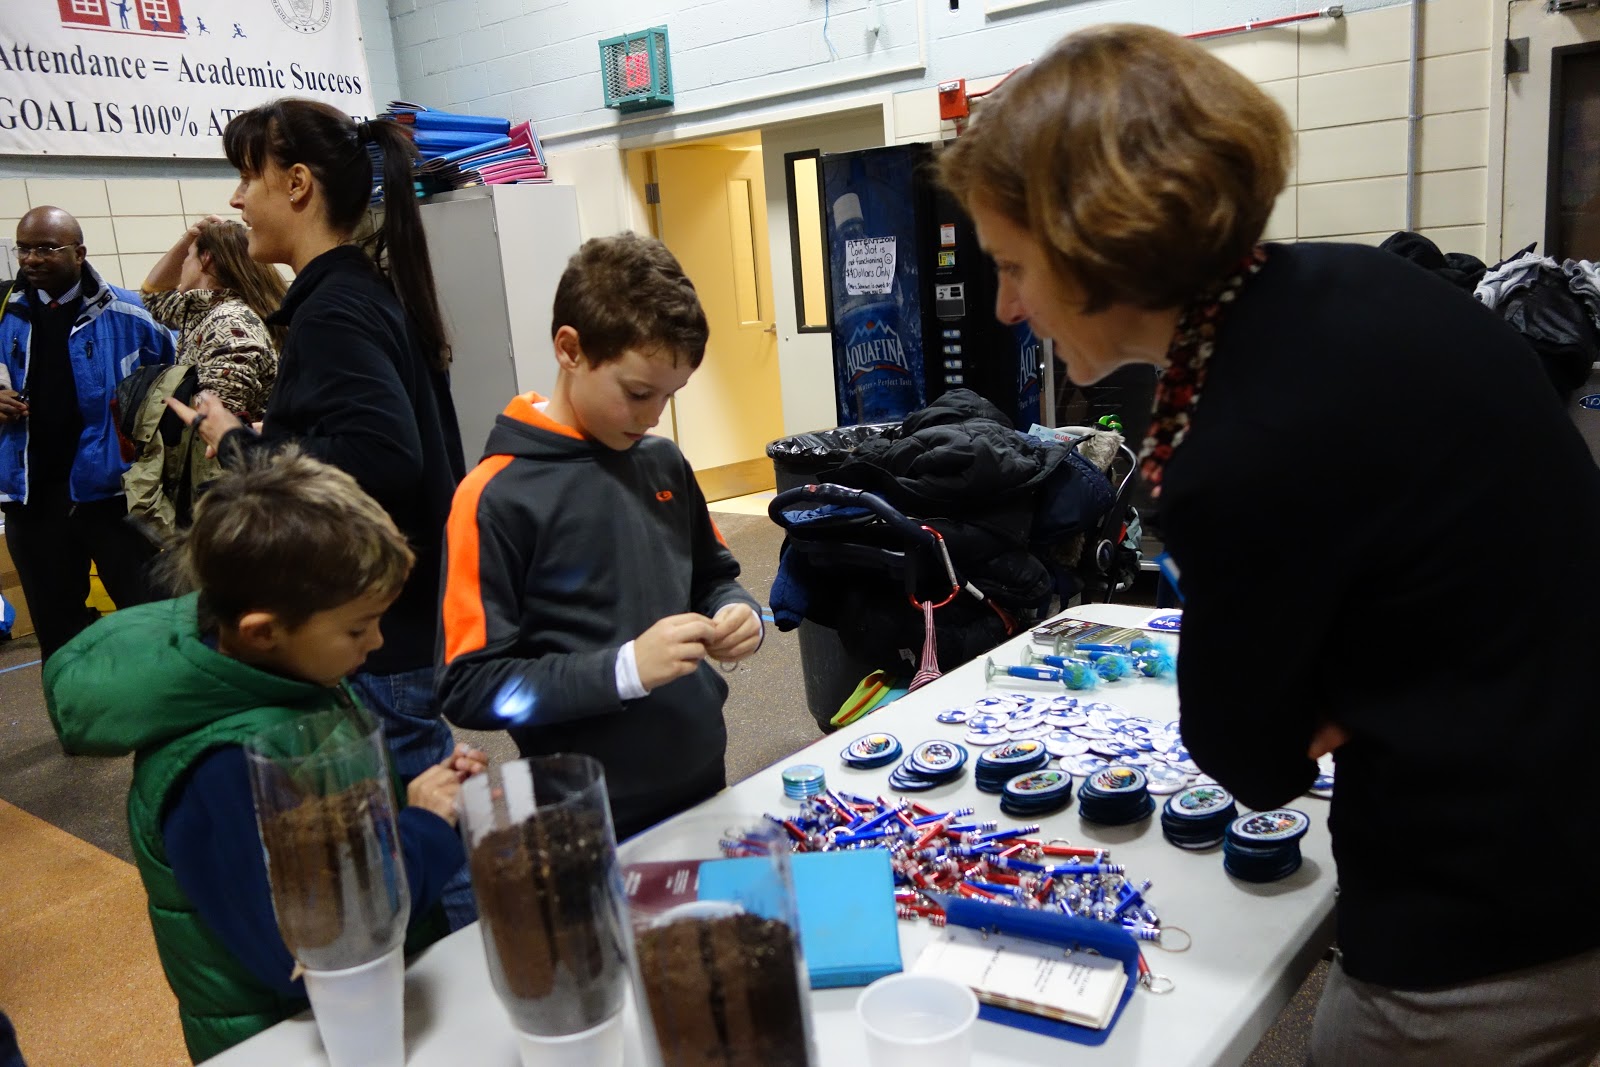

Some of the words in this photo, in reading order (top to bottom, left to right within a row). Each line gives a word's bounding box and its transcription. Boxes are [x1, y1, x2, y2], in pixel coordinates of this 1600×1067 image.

[0, 41, 147, 80] Attendance
[178, 53, 286, 89] Academic
[290, 62, 362, 95] Success
[0, 96, 87, 132] GOAL
[92, 102, 123, 134] IS
[130, 104, 199, 137] 100%
[847, 236, 896, 249] ATTENTION
[865, 244, 878, 255] Slot
[880, 246, 886, 254] is
[876, 265, 891, 281] Only
[845, 333, 909, 383] AQUAFINA
